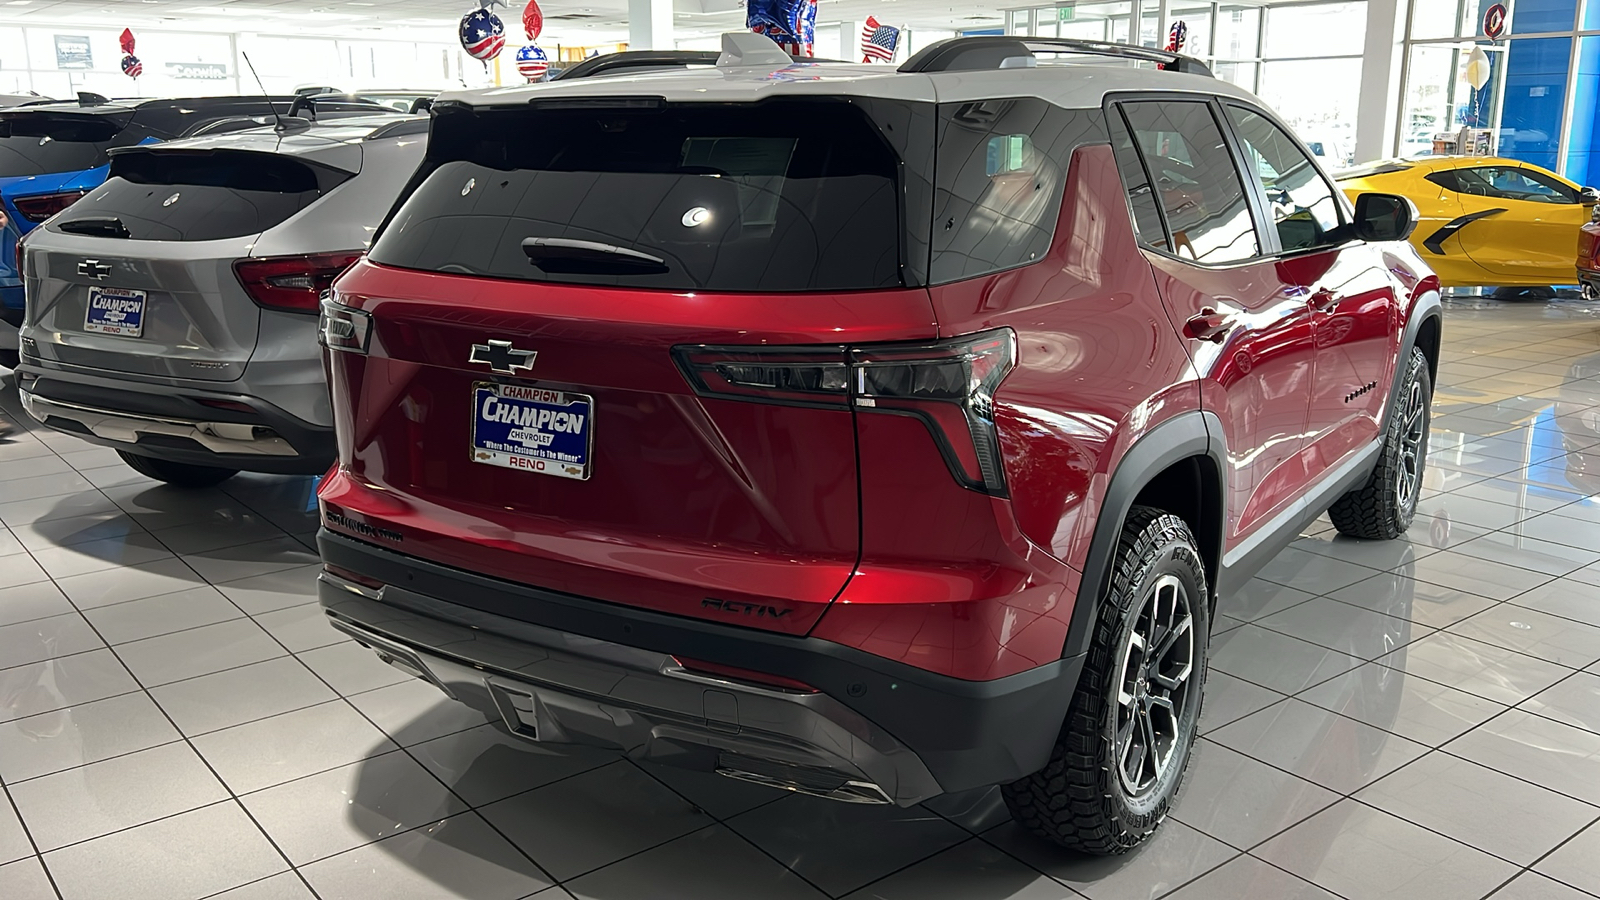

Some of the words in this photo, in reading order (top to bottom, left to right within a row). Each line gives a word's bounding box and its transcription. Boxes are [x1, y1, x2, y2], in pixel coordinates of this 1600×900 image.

[92, 294, 141, 313] CHAMPION
[102, 326, 121, 334] RENO
[503, 386, 559, 403] CHAMPION
[482, 396, 584, 435] CHAMPION
[510, 430, 551, 444] CHEVROLET
[503, 443, 514, 453] The
[514, 445, 540, 457] Customer
[540, 448, 546, 458] Is
[546, 450, 557, 459] The
[509, 456, 545, 471] RENO
[1171, 546, 1206, 621] GENERAL
[701, 598, 793, 617] ACTIV
[1116, 793, 1167, 829] GRABBER
